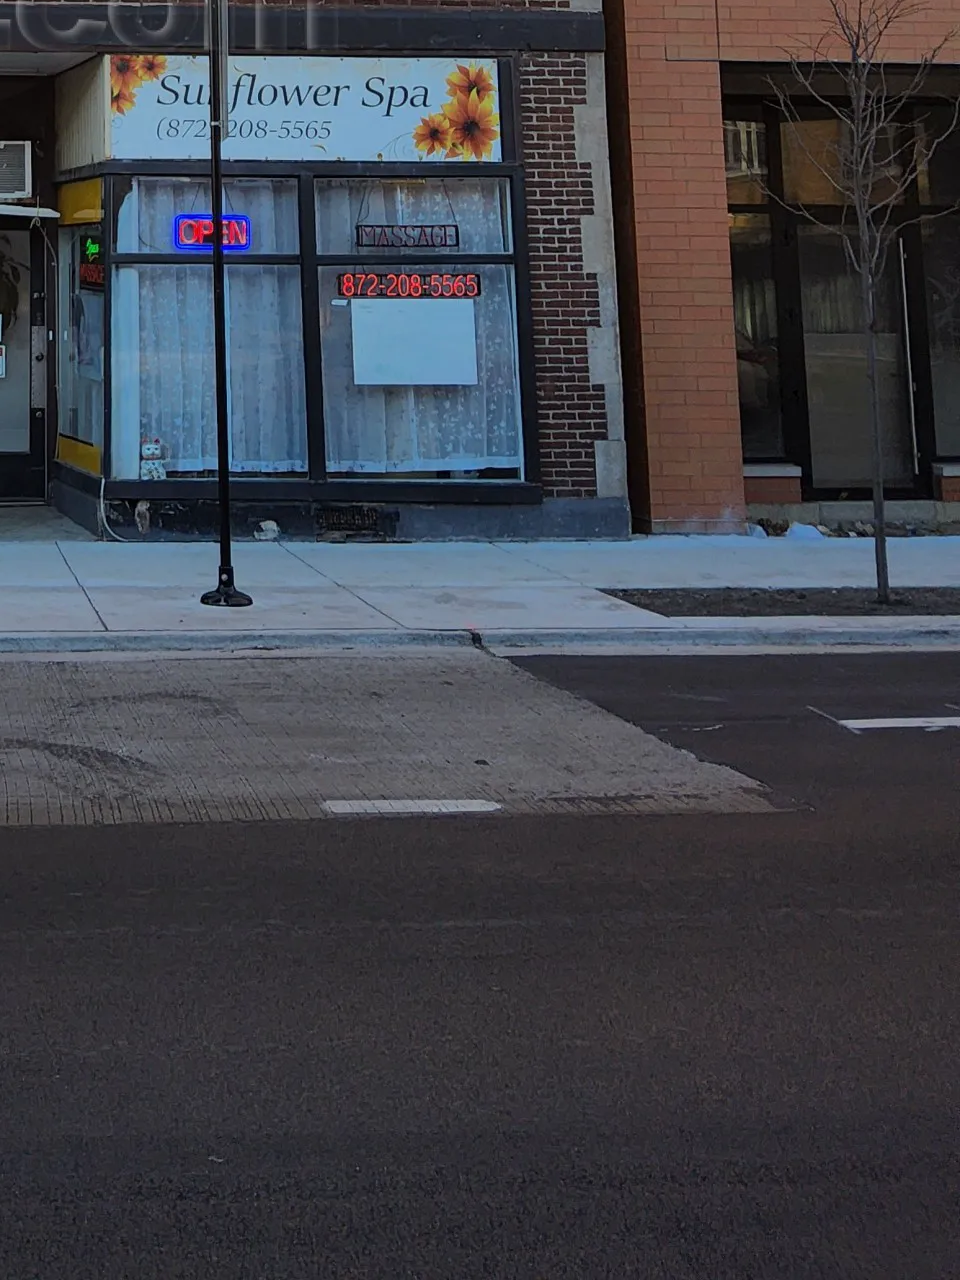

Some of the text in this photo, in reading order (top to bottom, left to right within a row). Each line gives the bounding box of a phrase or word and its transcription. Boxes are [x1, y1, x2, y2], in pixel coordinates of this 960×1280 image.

[156, 73, 432, 118] Suflower Spa
[156, 118, 212, 141] (872
[359, 225, 456, 247] MASSAGE
[342, 273, 478, 297] 872-208-5565
